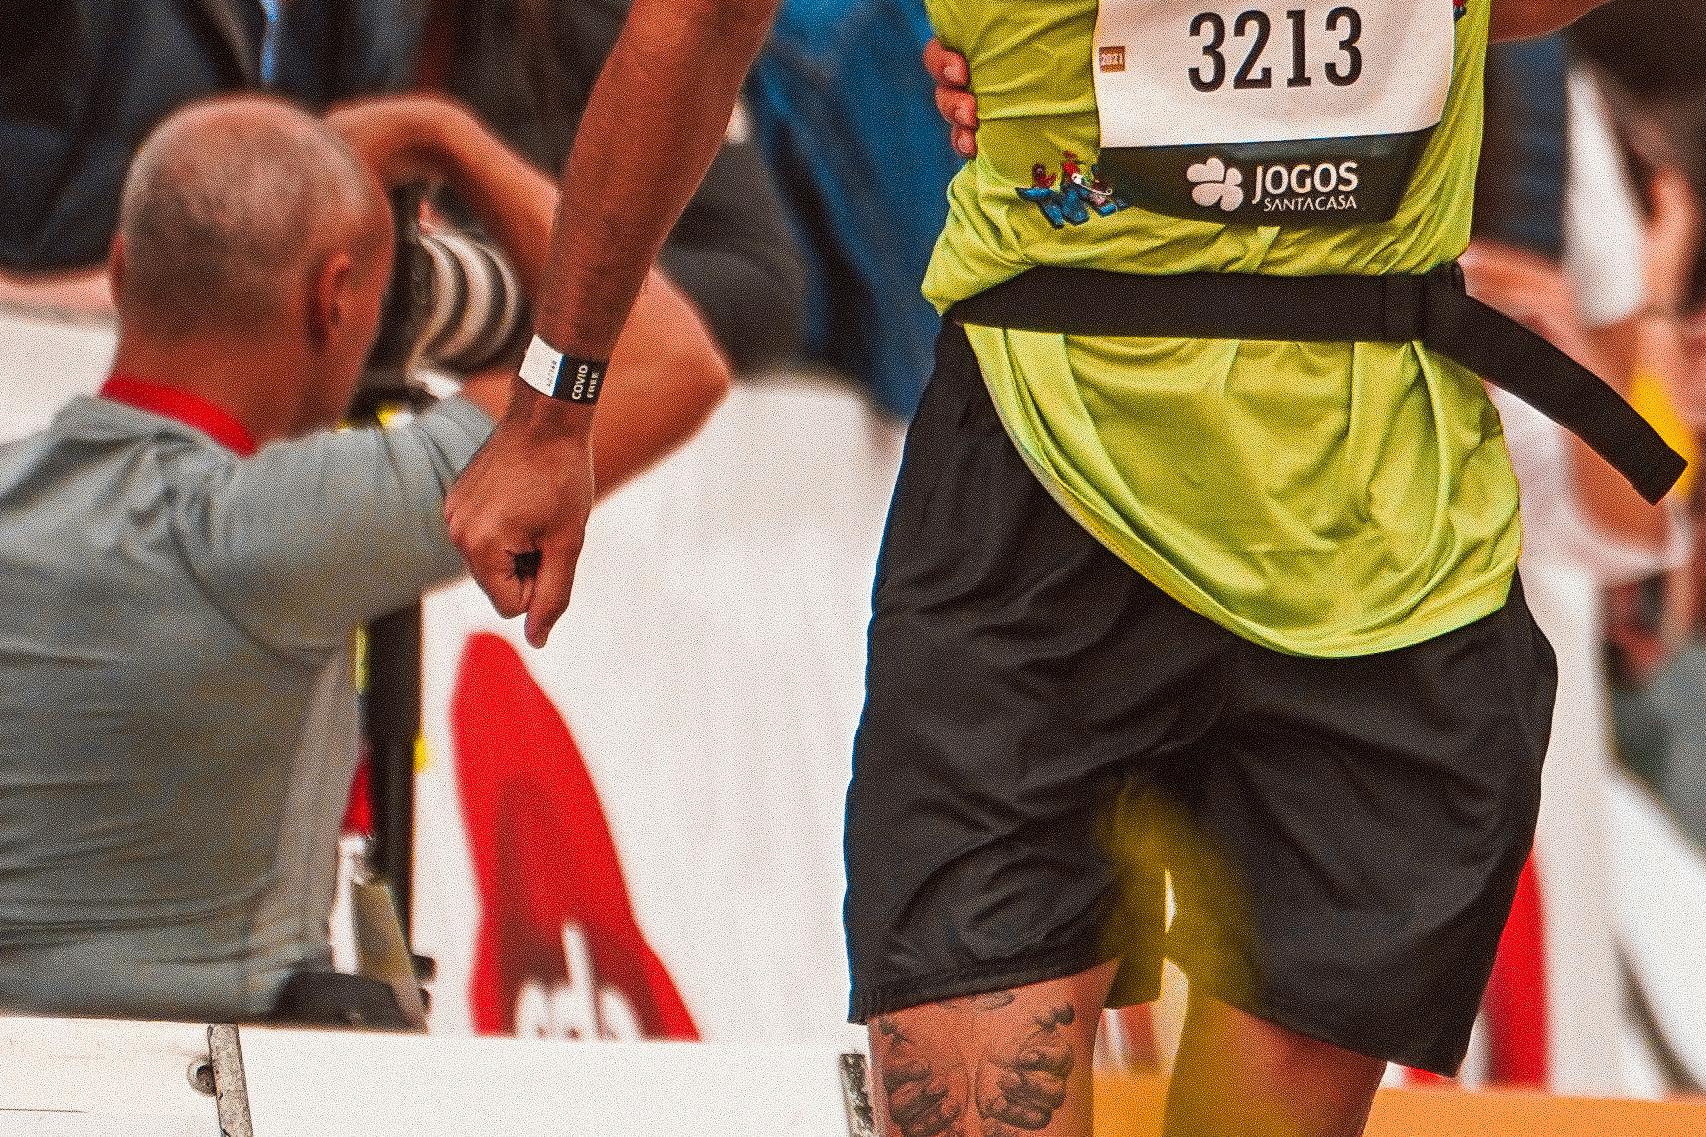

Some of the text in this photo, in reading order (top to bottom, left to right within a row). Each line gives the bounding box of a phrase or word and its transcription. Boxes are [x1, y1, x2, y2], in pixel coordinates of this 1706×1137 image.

[1187, 5, 1362, 93] 3213
[1252, 162, 1358, 204] JOGOS
[1263, 195, 1357, 212] SANTACASA
[571, 364, 589, 400] COVID
[586, 371, 600, 399] FREE
